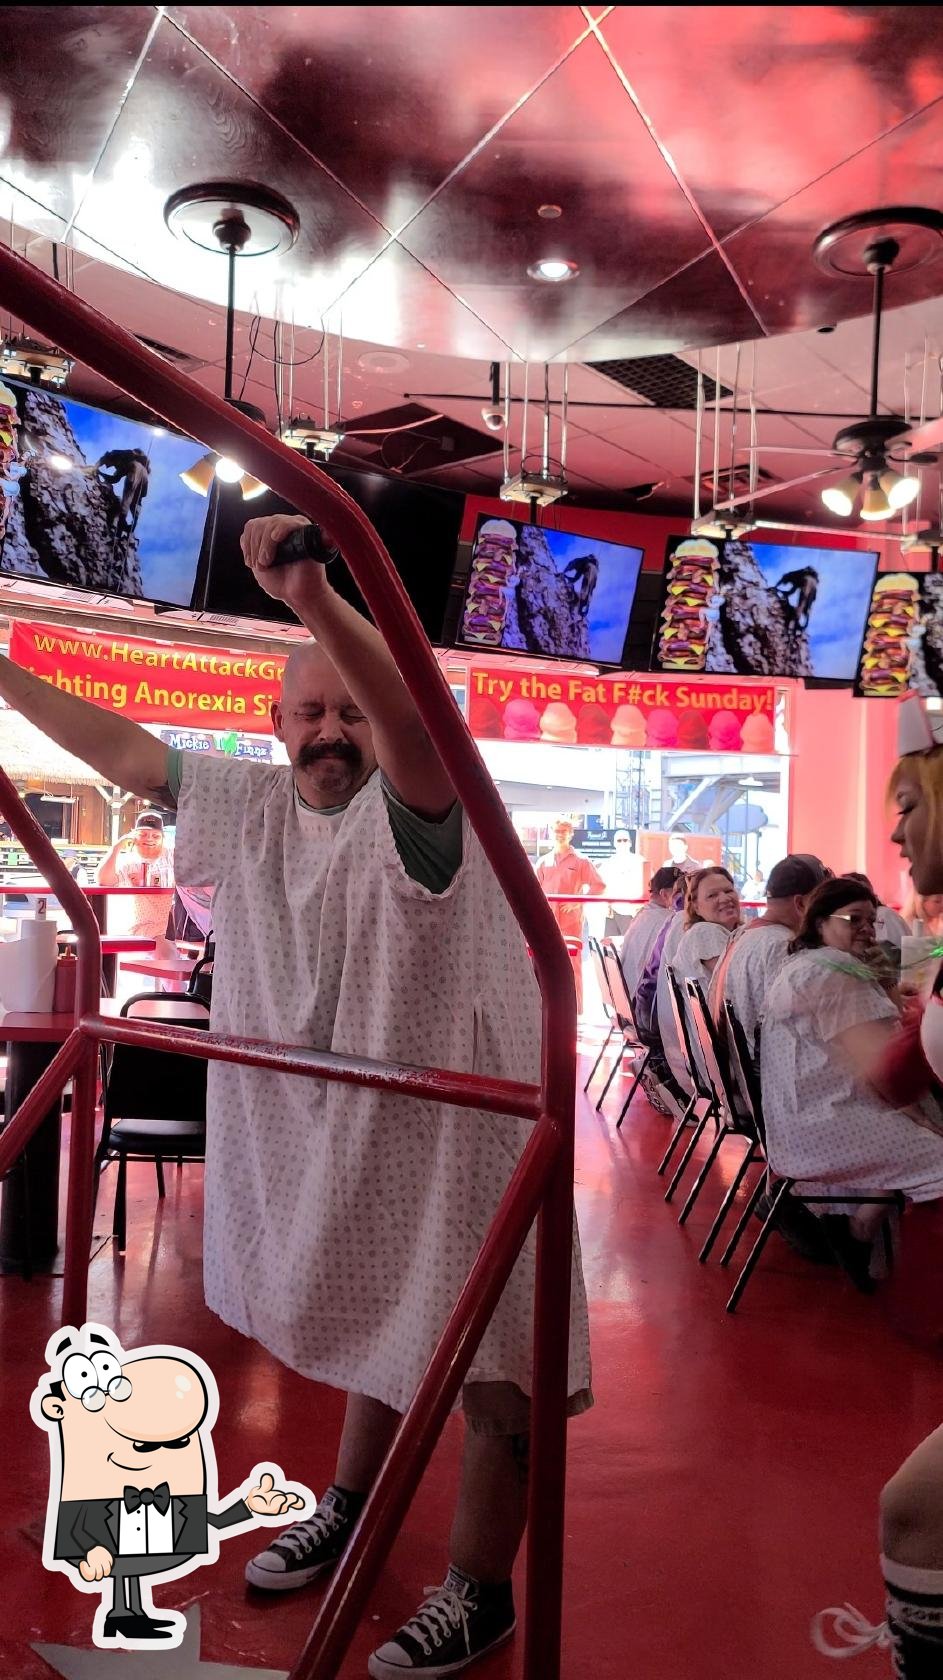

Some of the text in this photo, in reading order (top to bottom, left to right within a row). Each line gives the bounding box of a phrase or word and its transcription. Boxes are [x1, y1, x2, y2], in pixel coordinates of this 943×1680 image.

[29, 667, 127, 708] hting
[134, 681, 246, 714] Anorexia
[472, 671, 773, 715] Try the Fat F#ck Sunday!
